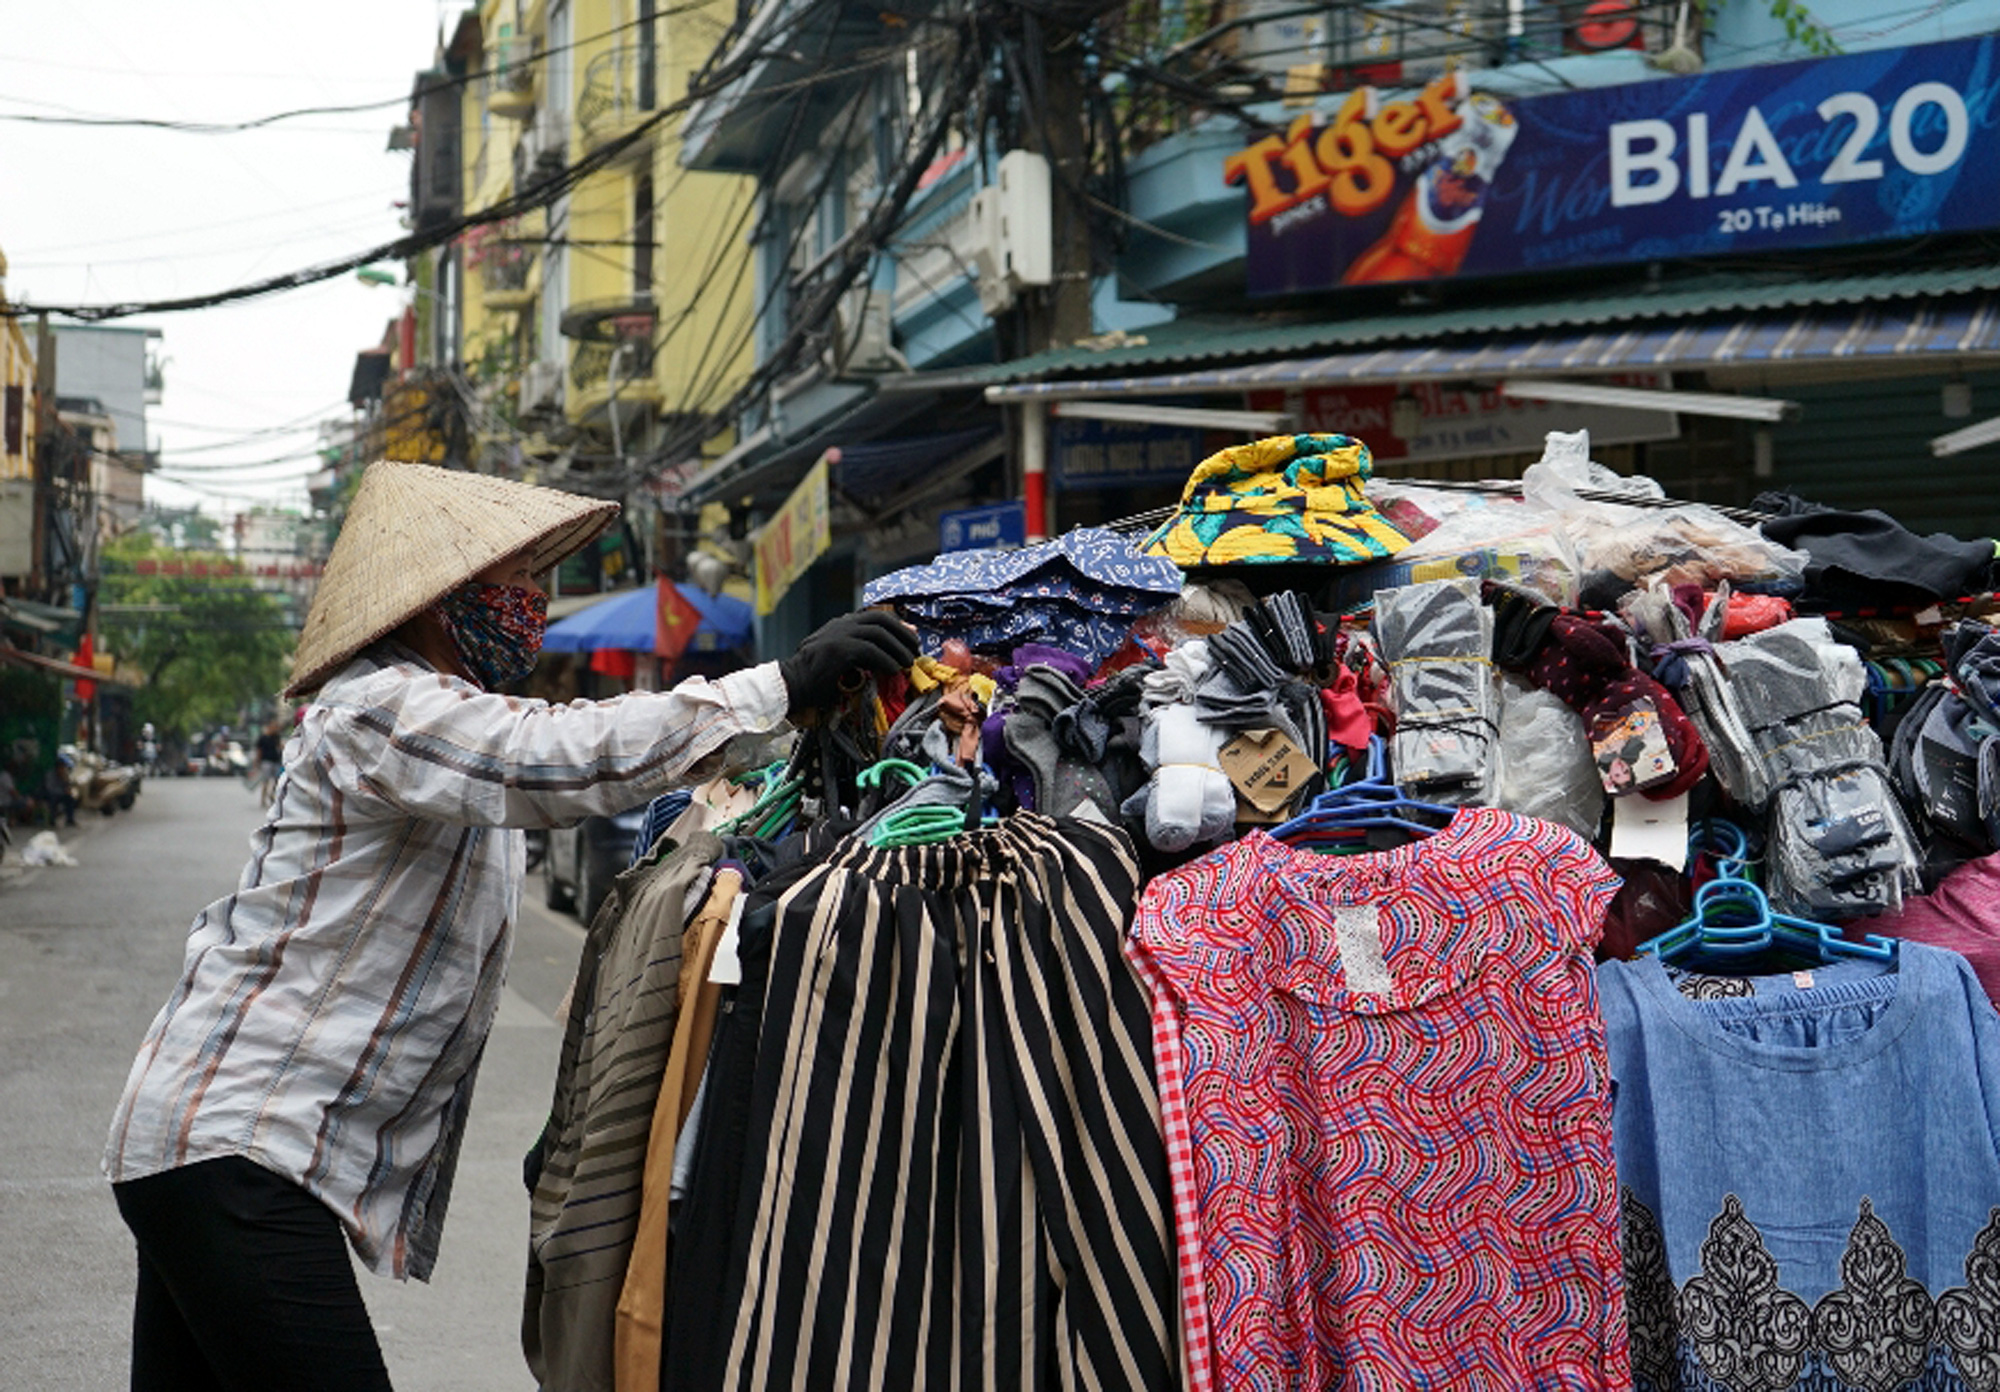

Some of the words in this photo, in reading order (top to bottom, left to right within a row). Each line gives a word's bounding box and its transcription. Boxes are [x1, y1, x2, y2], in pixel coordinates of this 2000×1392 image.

[1224, 74, 1466, 225] Tiger
[1609, 105, 1798, 207] BIA
[1816, 81, 1970, 185] 20
[1717, 209, 1752, 233] 20
[1754, 206, 1785, 232] Tạ
[1304, 406, 1386, 433] AIGON
